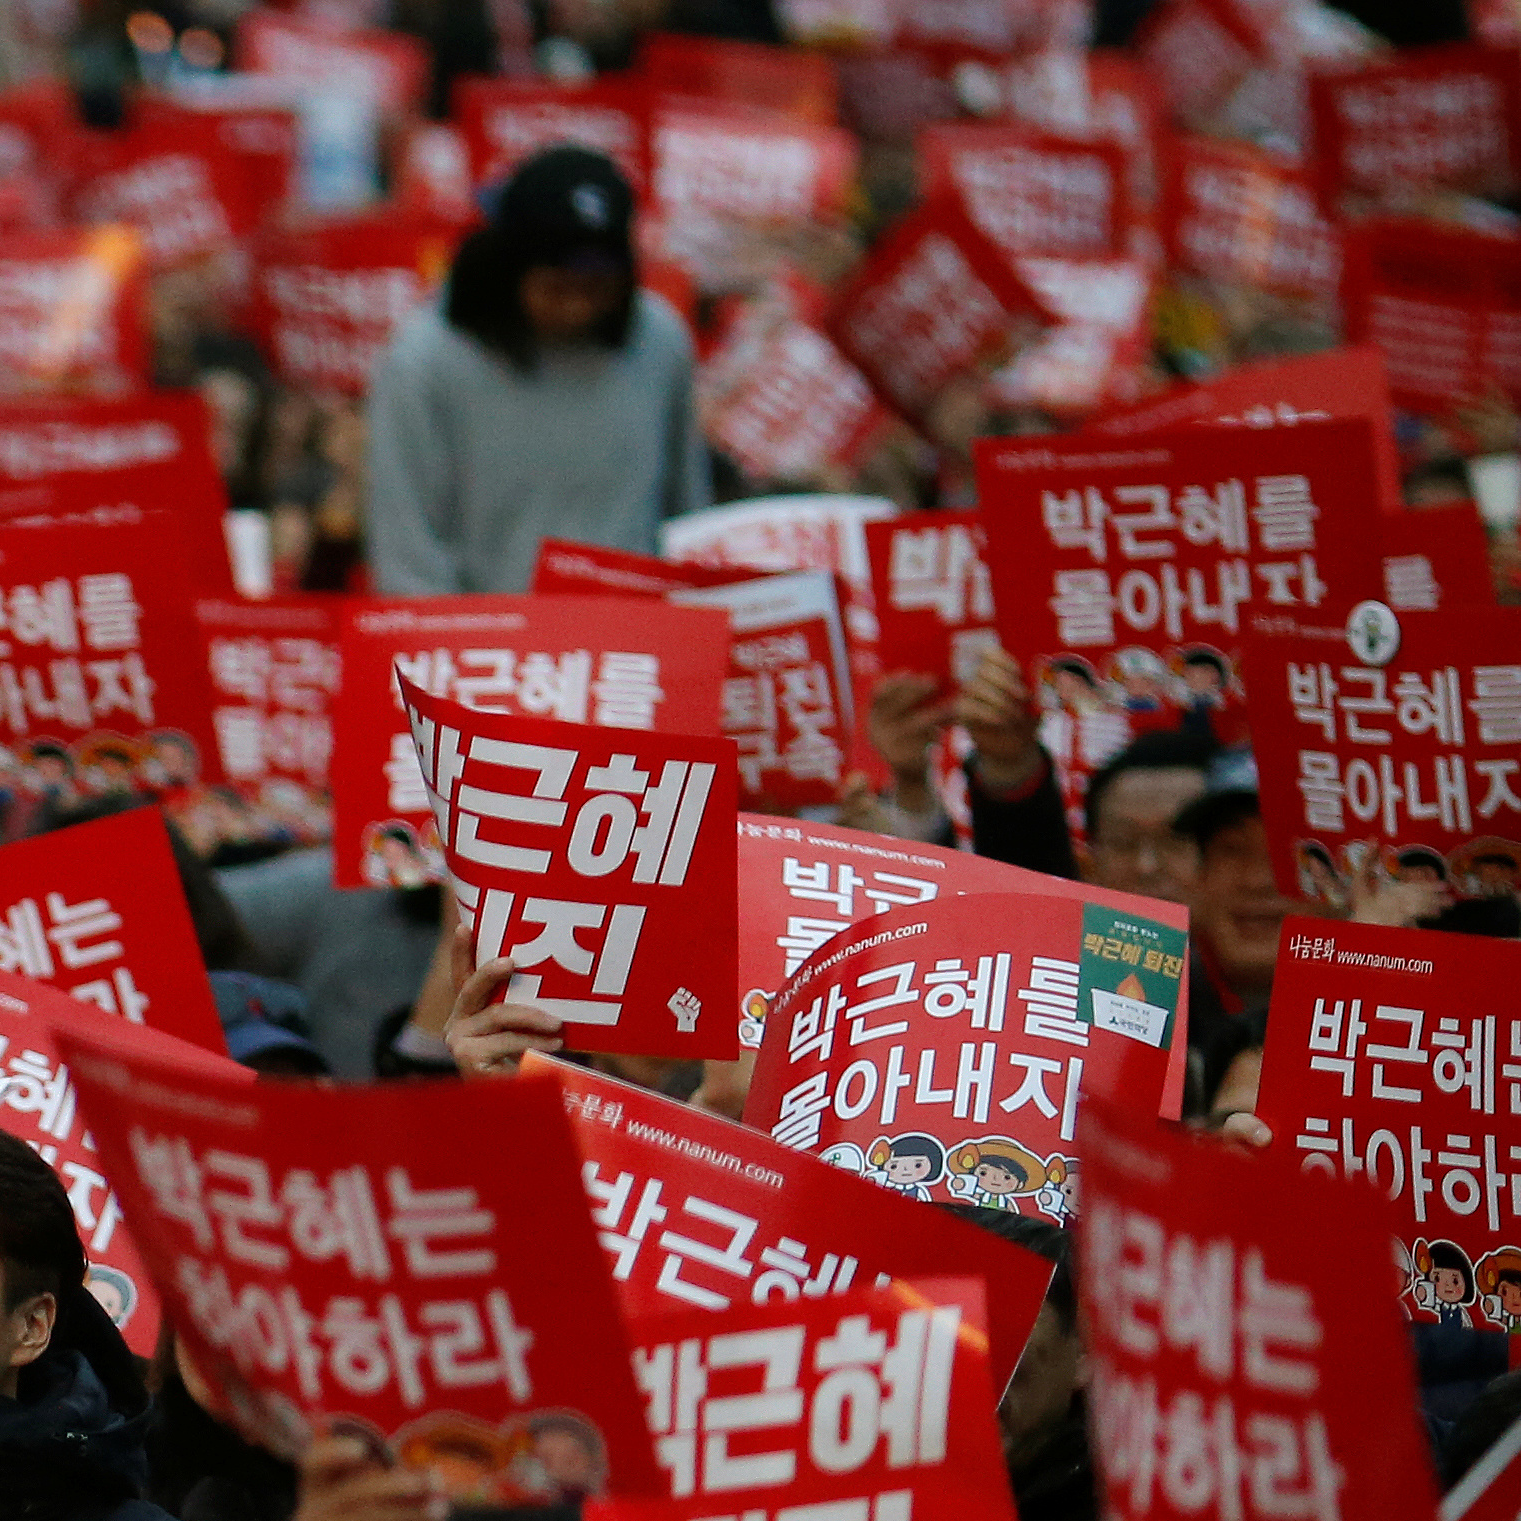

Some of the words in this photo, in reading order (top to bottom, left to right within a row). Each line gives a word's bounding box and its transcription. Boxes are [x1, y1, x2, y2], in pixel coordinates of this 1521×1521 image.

[1042, 473, 1320, 562] 박근혜를
[1050, 553, 1328, 648] 몰아내자
[1287, 661, 1521, 748] 박근혜를
[408, 702, 718, 888] 박근혜
[782, 856, 940, 916] 박근
[808, 835, 947, 869] www.nanum.com
[813, 920, 929, 975] www.nanum.com
[1083, 933, 1143, 967] 박근혜
[1142, 949, 1185, 980] 퇴진
[1290, 933, 1335, 963] 나눔문화
[1337, 949, 1434, 975] www.nanum.com
[788, 952, 1091, 1064] 박근혜를
[771, 1040, 1084, 1151] 몰아내자
[625, 1117, 786, 1192] www.nanum.com
[127, 1124, 497, 1283] 박근혜는
[580, 1159, 891, 1312] 박근혜
[633, 1304, 961, 1501] 박근혜
